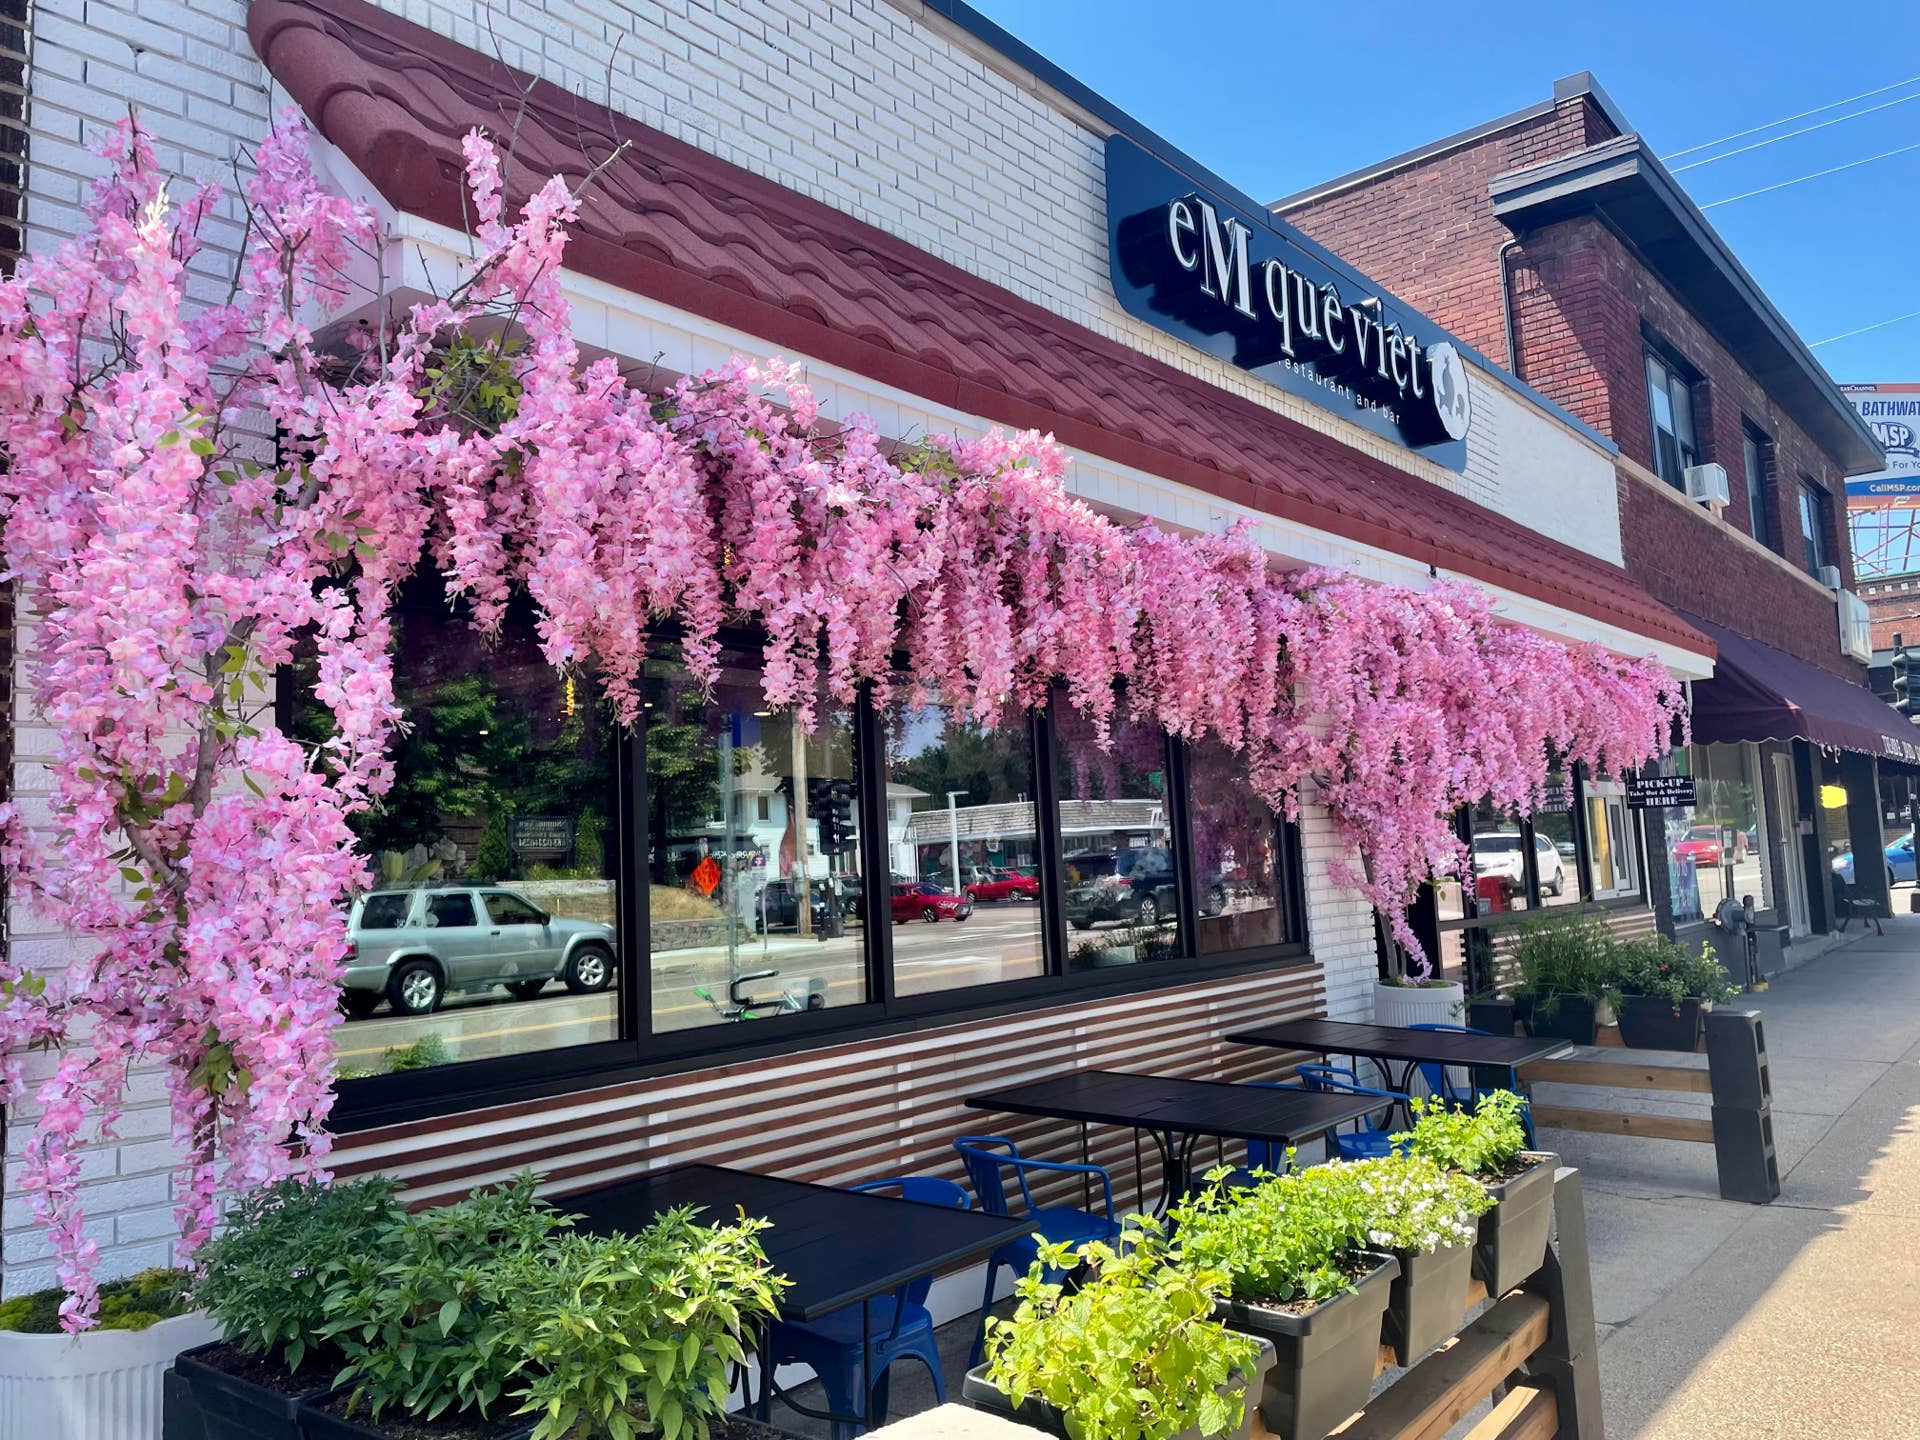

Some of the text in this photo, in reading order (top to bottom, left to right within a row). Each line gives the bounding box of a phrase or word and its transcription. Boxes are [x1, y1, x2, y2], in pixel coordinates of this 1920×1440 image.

[1265, 258, 1346, 358] quê
[1278, 358, 1400, 424] estaurant and bar
[1871, 422, 1909, 447] MSP
[1892, 461, 1908, 469] For
[1636, 778, 1684, 789] PICK-UP
[1666, 787, 1693, 795] Delivery
[1645, 796, 1678, 806] HERE
